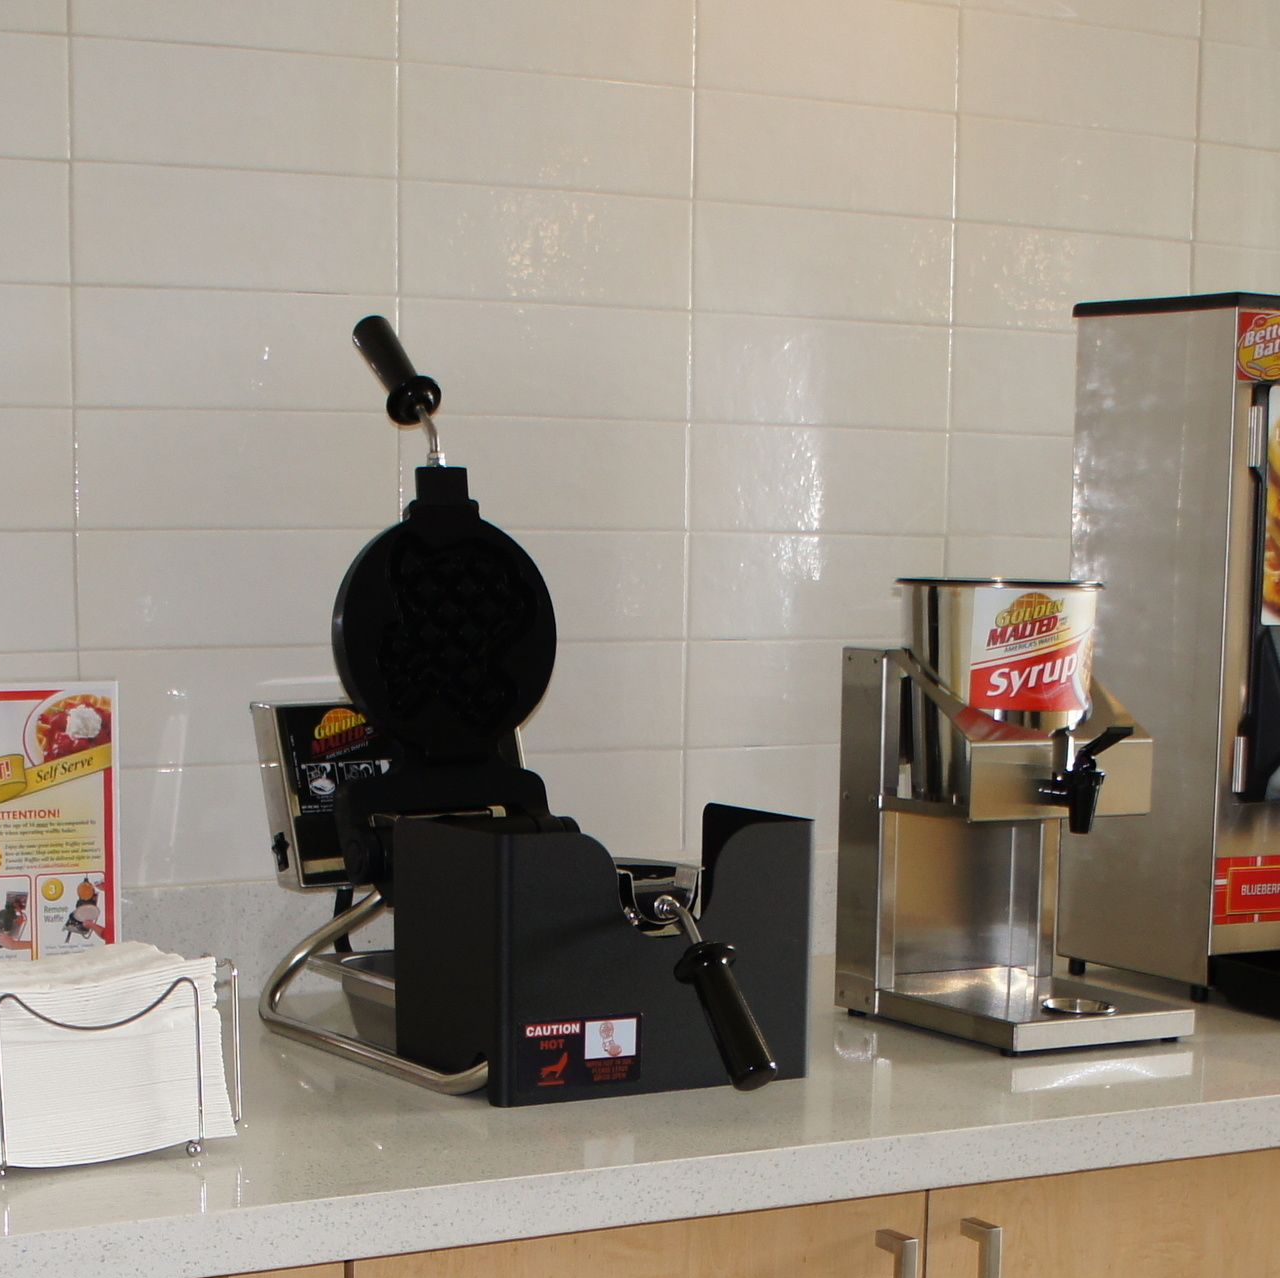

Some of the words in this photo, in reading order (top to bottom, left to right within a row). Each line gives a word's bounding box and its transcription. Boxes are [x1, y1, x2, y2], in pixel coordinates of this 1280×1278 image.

[995, 598, 1065, 628] GOLDEN
[986, 614, 1059, 648] MALTED
[986, 653, 1078, 698] Syrup
[36, 763, 60, 783] Self
[60, 756, 94, 776] Serve
[48, 885, 57, 895] 3
[526, 1023, 581, 1038] CAUTION
[540, 1039, 565, 1050] HOT
